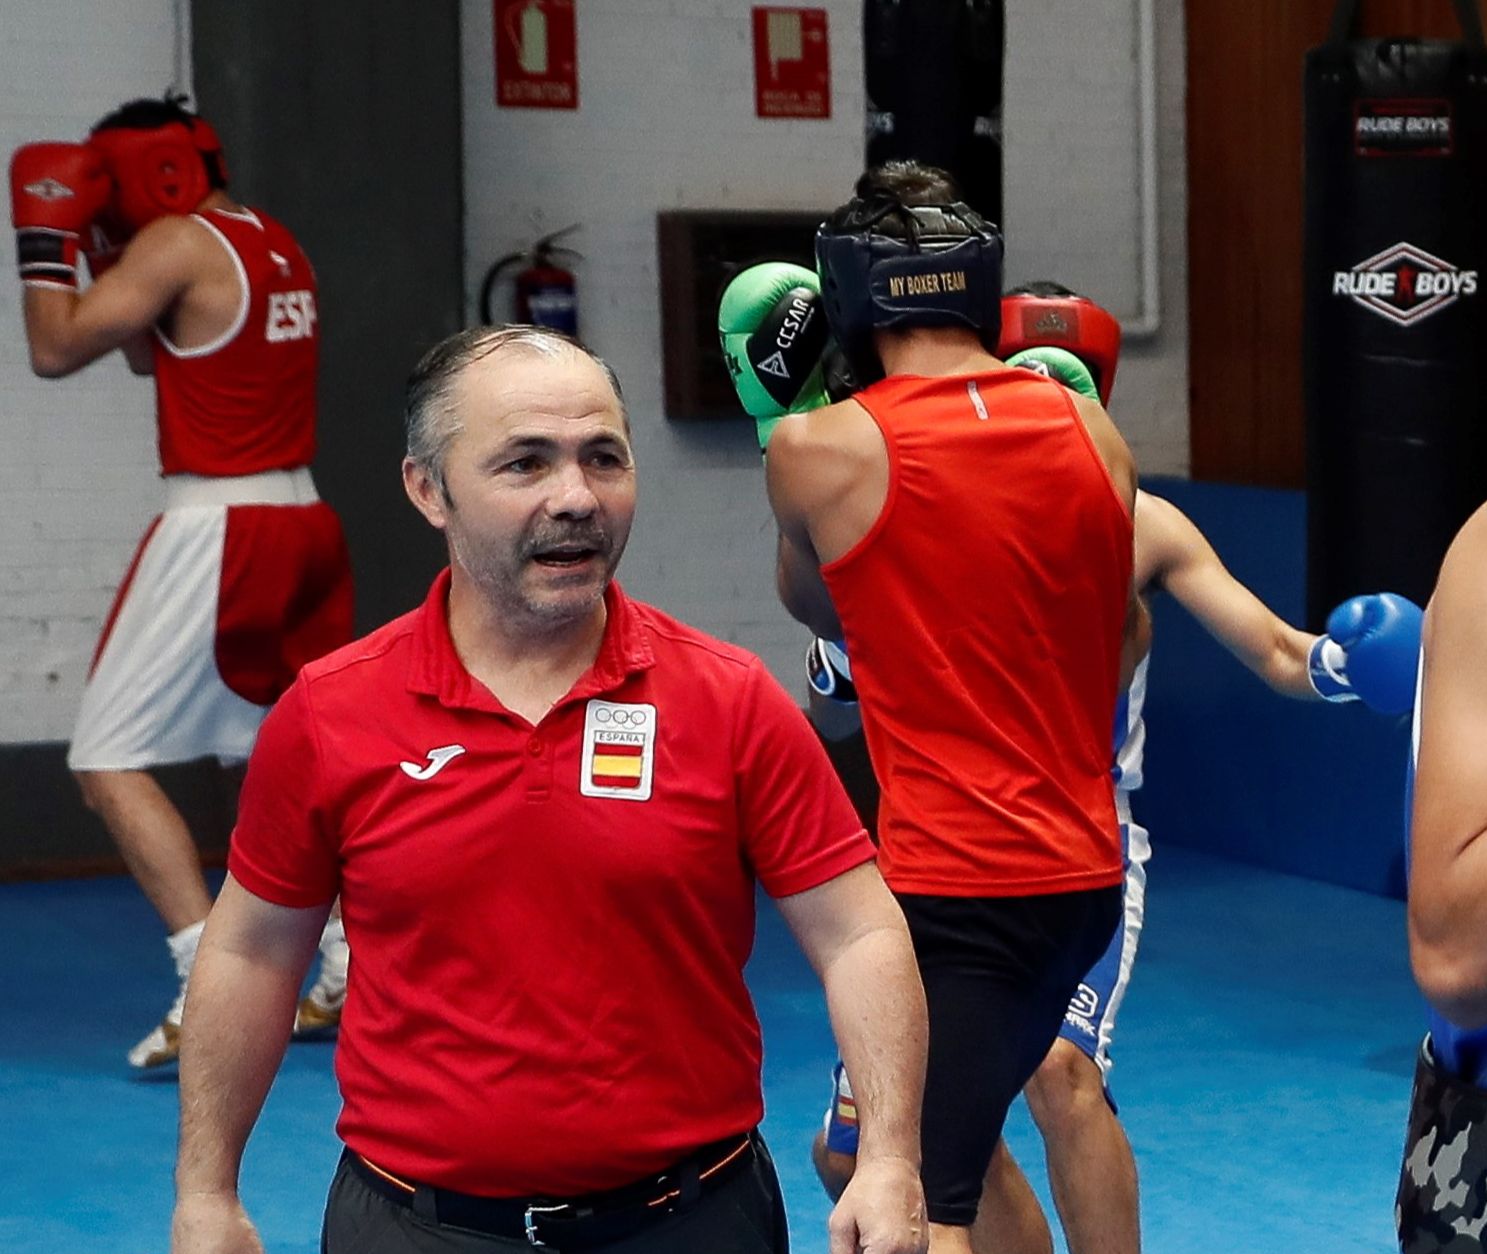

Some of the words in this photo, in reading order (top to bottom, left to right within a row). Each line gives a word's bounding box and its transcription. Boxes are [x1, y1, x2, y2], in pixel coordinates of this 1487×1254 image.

[1356, 116, 1402, 132] RUDE
[1405, 116, 1450, 132] BOYS
[889, 277, 906, 297] MY
[907, 274, 940, 296] BOXER
[939, 271, 967, 292] TEAM
[1332, 271, 1398, 296] RUDE
[1415, 270, 1479, 296] BOYS
[599, 732, 640, 743] ESPAÑA
